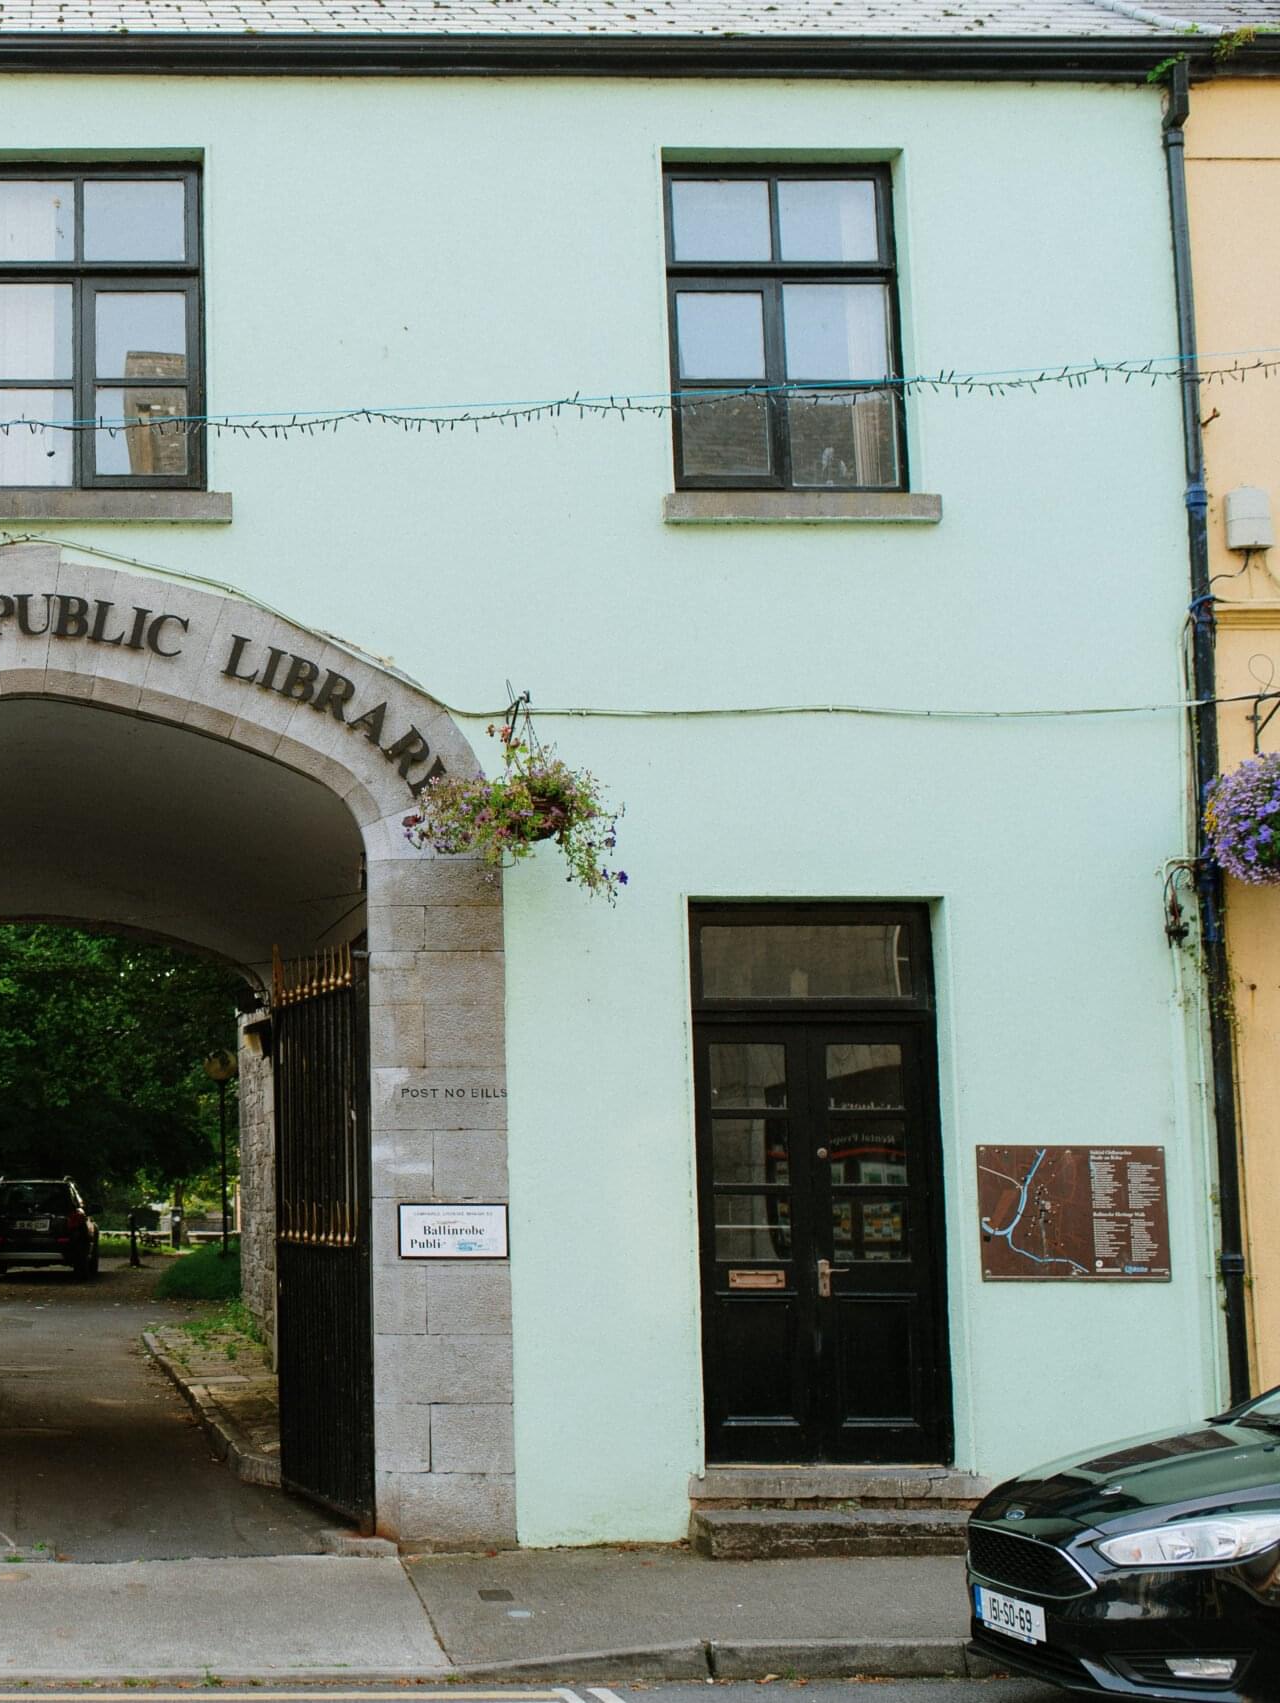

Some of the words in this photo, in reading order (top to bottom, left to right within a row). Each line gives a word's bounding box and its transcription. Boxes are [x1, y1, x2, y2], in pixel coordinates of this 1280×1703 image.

[400, 1087, 440, 1099] POST
[444, 1087, 466, 1099] NO
[423, 1224, 485, 1236] Ballinrobe
[410, 1238, 448, 1250] Publi
